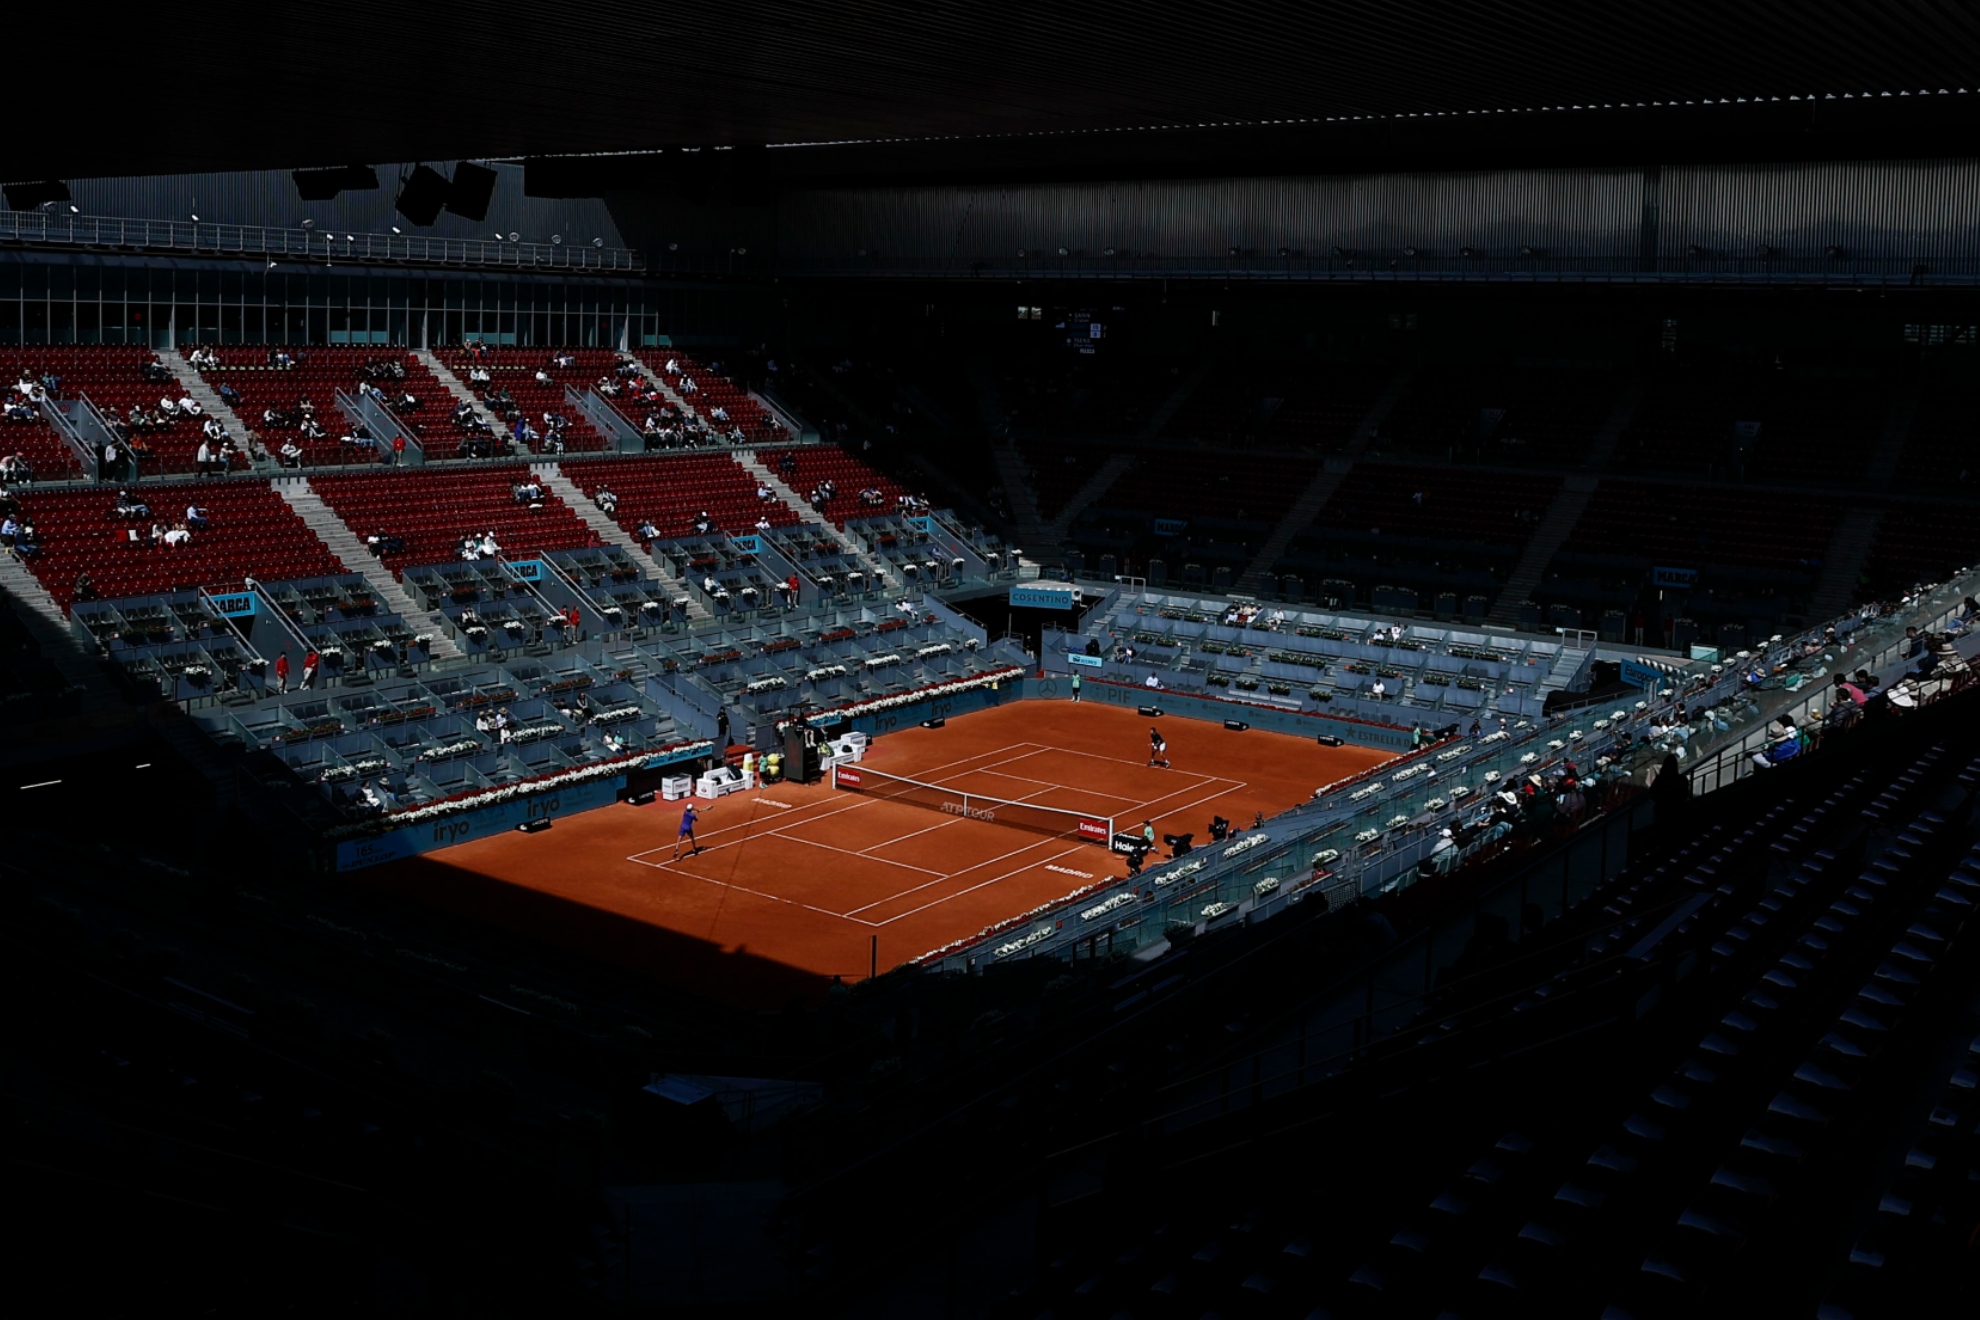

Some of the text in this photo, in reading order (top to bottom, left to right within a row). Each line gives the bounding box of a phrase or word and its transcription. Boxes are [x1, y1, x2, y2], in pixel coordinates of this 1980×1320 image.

[1012, 593, 1069, 604] COSENTINO
[1108, 688, 1131, 704] PIF
[1358, 731, 1401, 747] ESTRELLA
[837, 771, 861, 783] Emirates
[940, 801, 995, 822] ATP TOUR
[434, 821, 470, 842] iryo
[1079, 822, 1107, 835] Emirates
[356, 844, 374, 857] 165
[1044, 864, 1094, 879] MADRID
